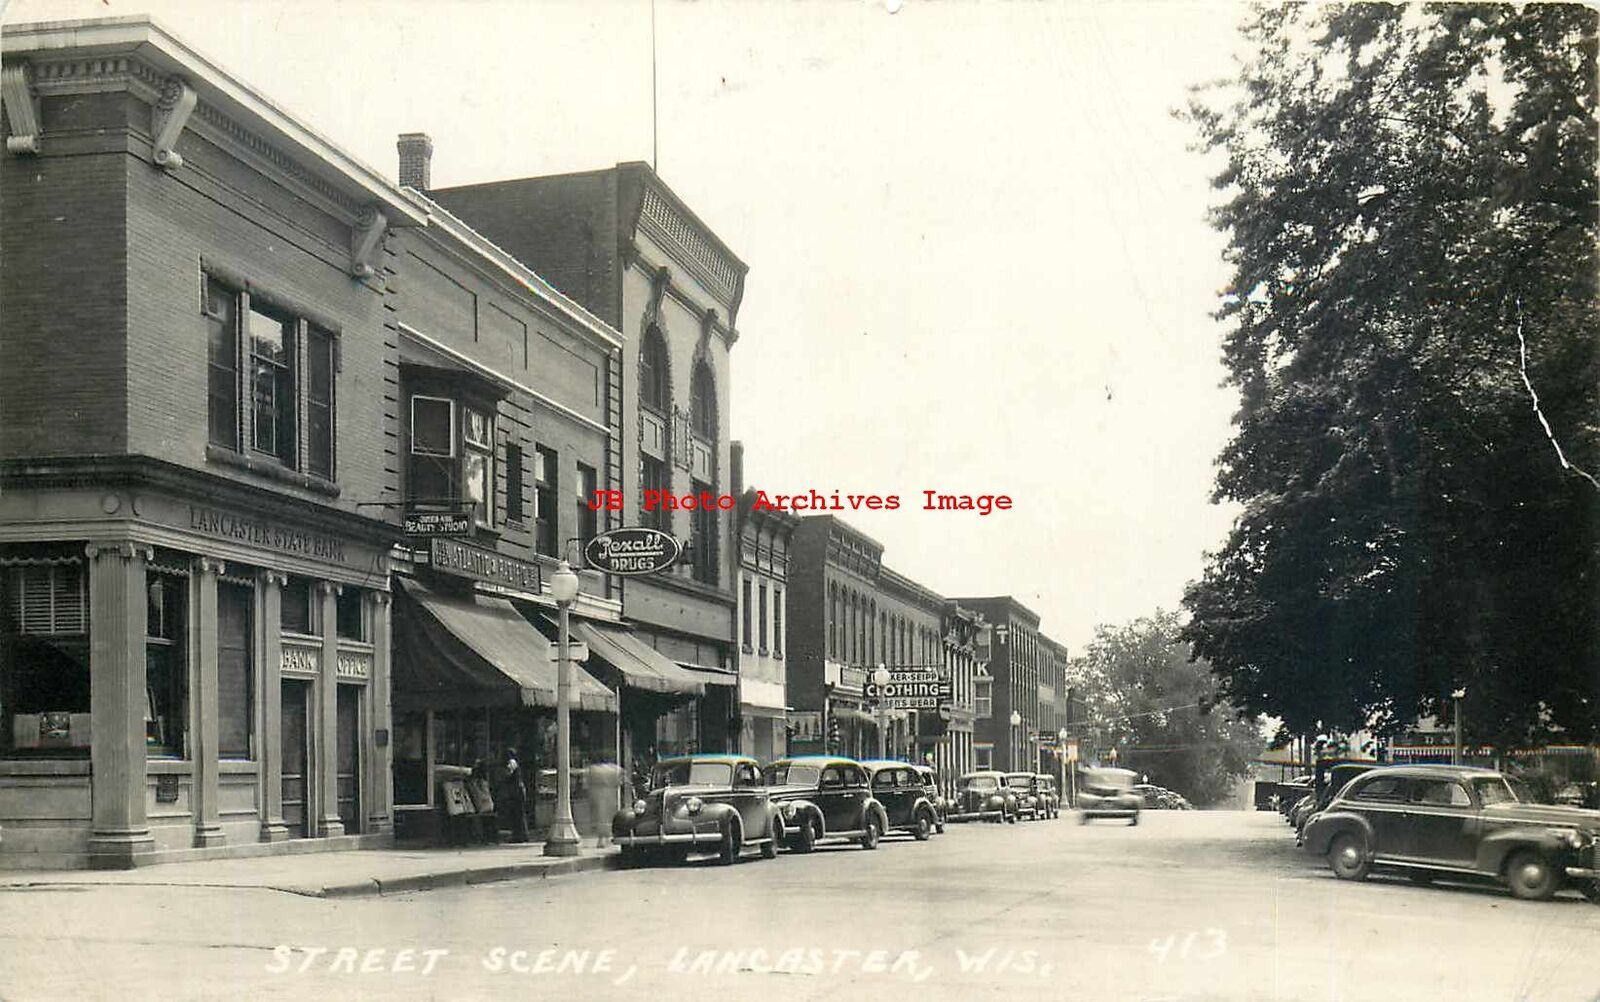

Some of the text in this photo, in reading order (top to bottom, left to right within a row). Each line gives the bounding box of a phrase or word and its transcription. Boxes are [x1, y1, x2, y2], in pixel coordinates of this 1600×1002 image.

[404, 519, 468, 532] BEAUTY STUDIO
[189, 508, 347, 563] LANCASTER STATE BANK
[597, 533, 663, 559] Rexall
[611, 557, 655, 570] DRUGS
[281, 649, 313, 670] BANK
[866, 684, 939, 697] CLOTHING
[910, 698, 936, 707] WEAR
